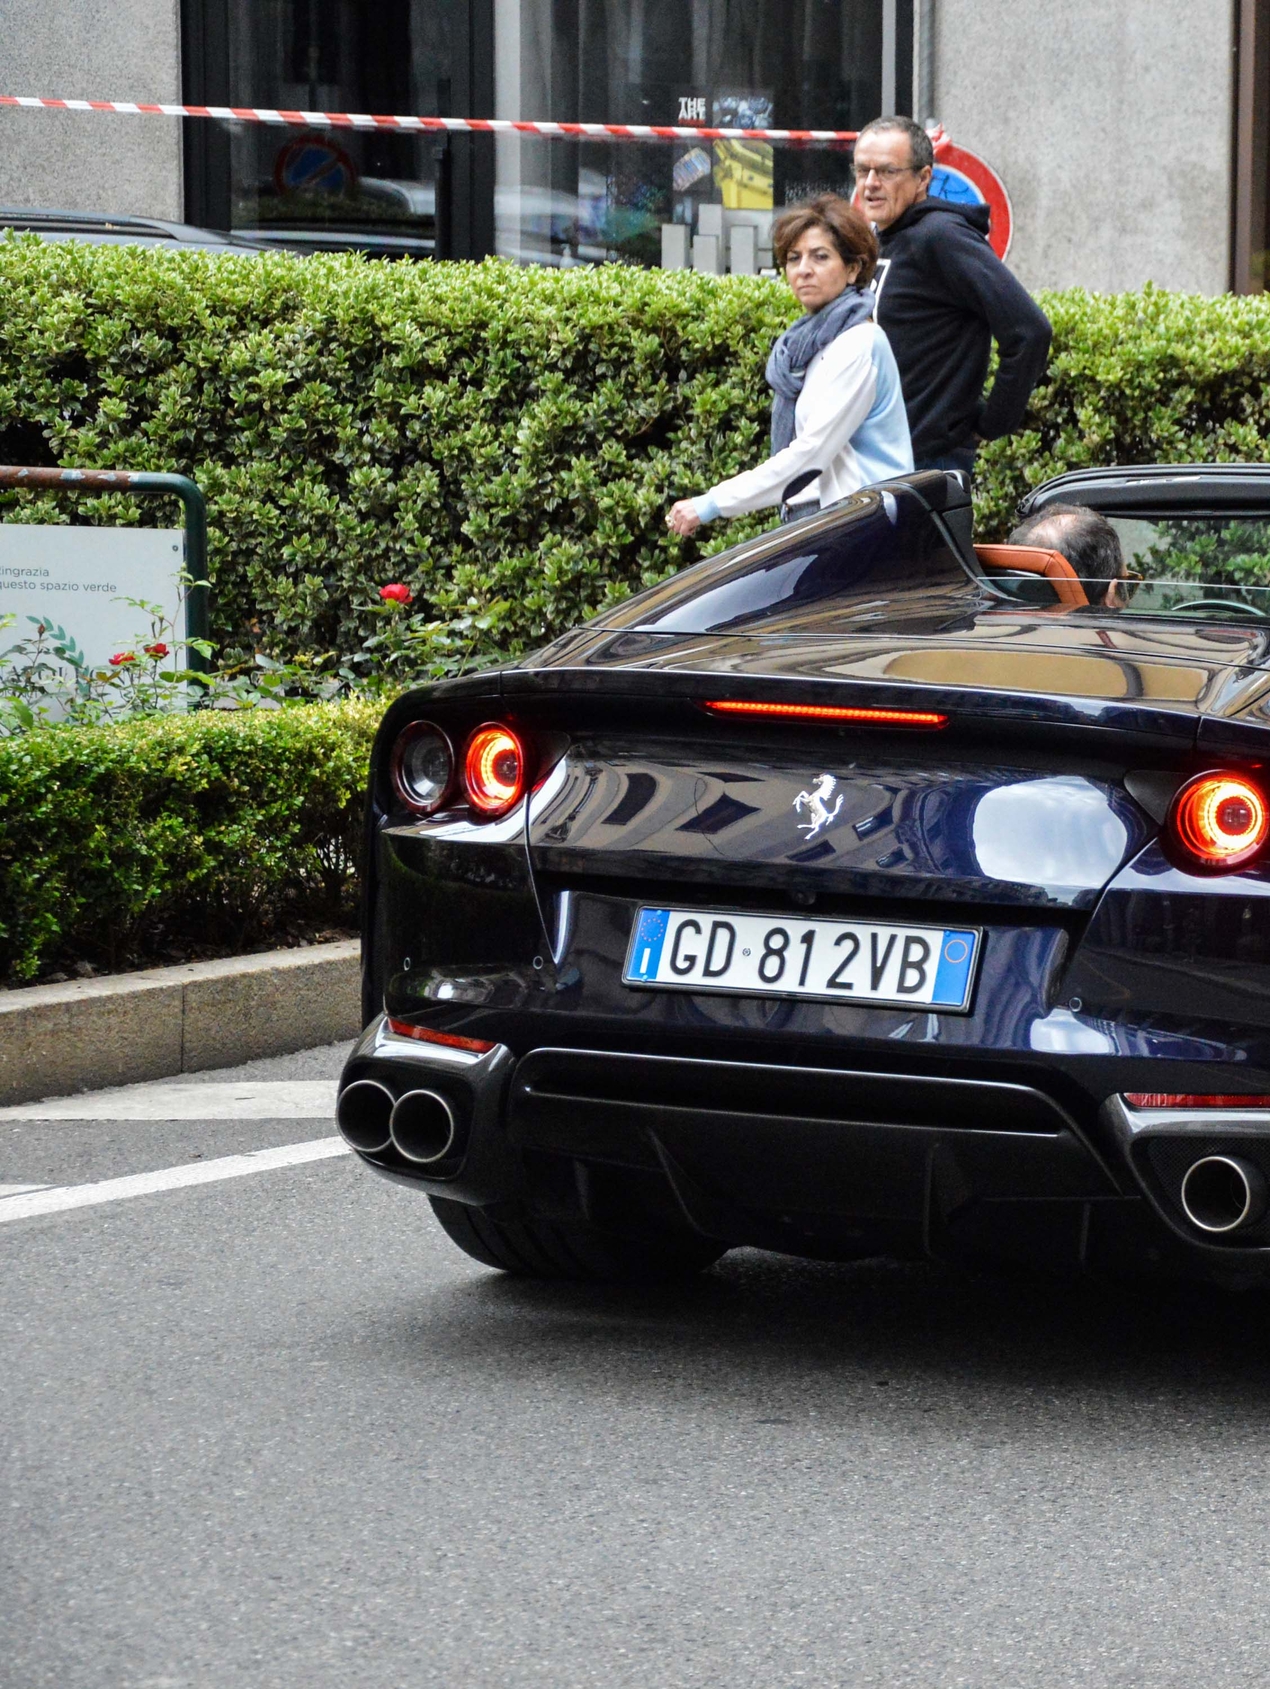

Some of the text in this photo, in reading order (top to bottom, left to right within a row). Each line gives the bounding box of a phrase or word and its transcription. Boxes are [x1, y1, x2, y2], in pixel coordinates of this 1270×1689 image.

[678, 97, 706, 109] THE
[0, 565, 50, 578] ingrazia
[40, 581, 79, 592] spazio
[83, 583, 117, 593] verde
